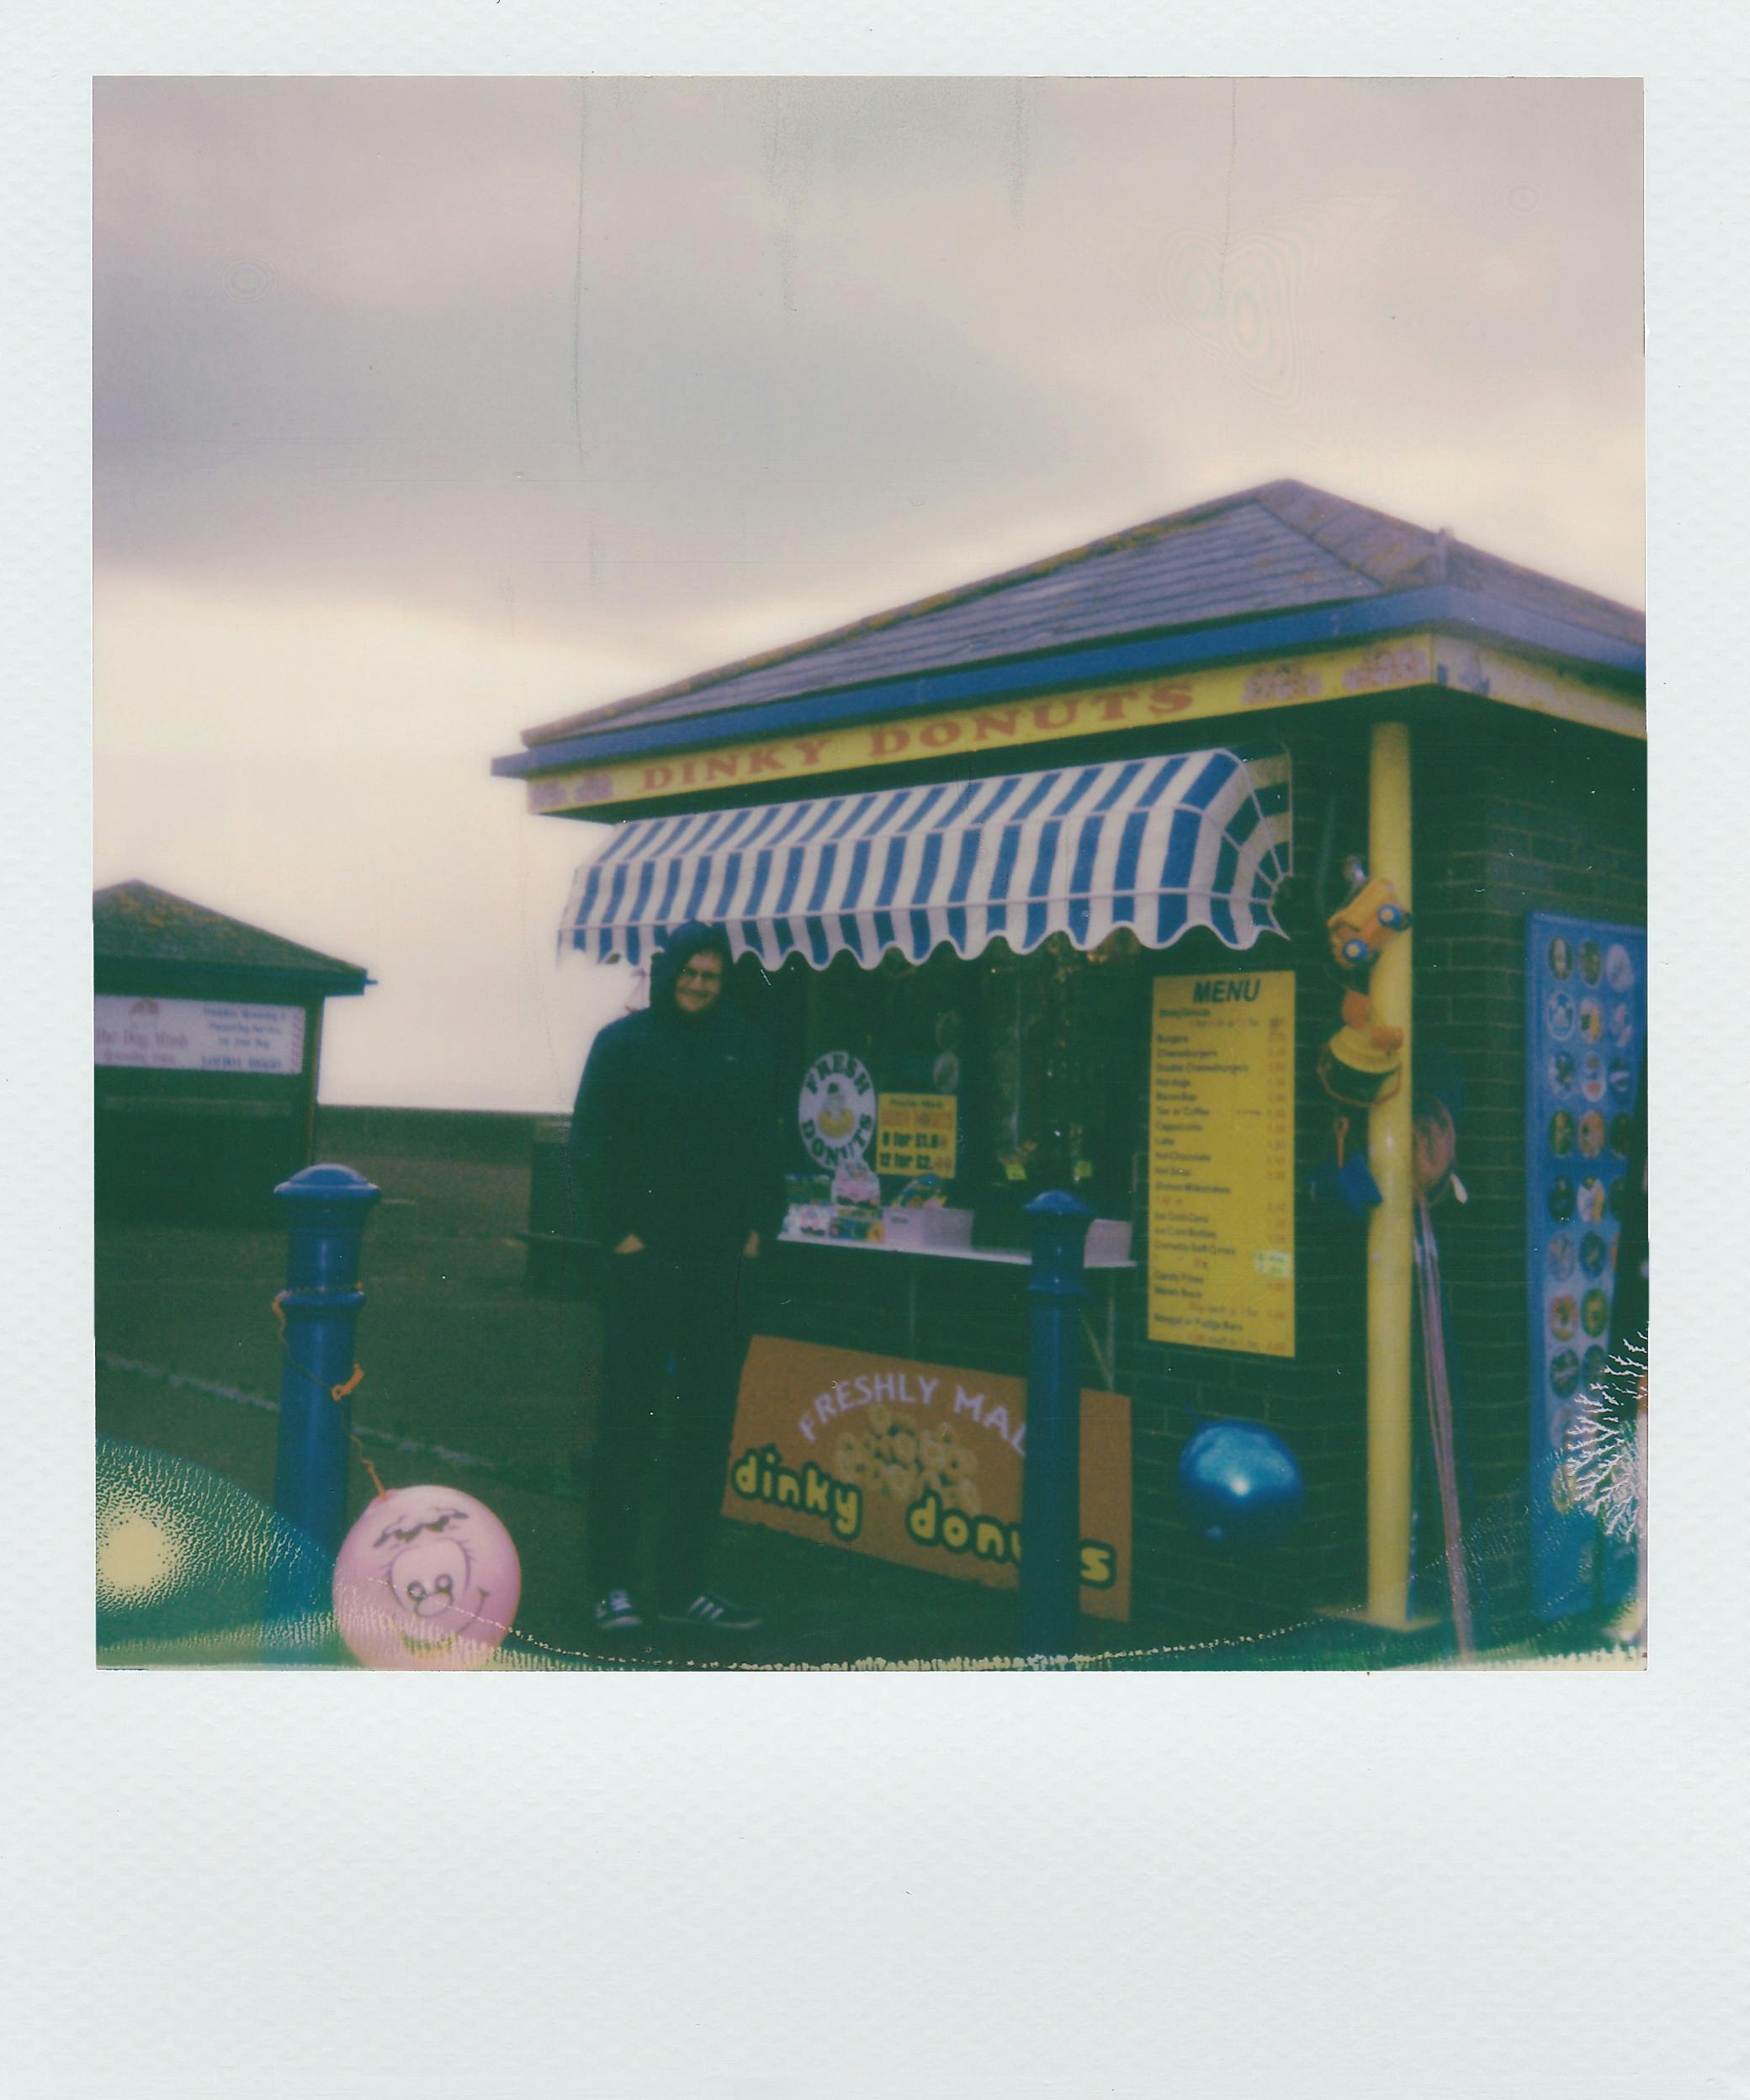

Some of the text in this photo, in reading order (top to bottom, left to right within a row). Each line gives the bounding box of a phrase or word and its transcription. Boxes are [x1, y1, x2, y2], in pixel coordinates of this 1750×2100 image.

[641, 681, 1194, 791] DINKY DONUTS
[1192, 979, 1261, 1003] MENU
[805, 1053, 871, 1095] FRESH
[803, 1113, 872, 1167] DONUTS
[798, 1373, 1026, 1457] FRESHLY MA
[732, 1444, 1116, 1591] dinky dons
